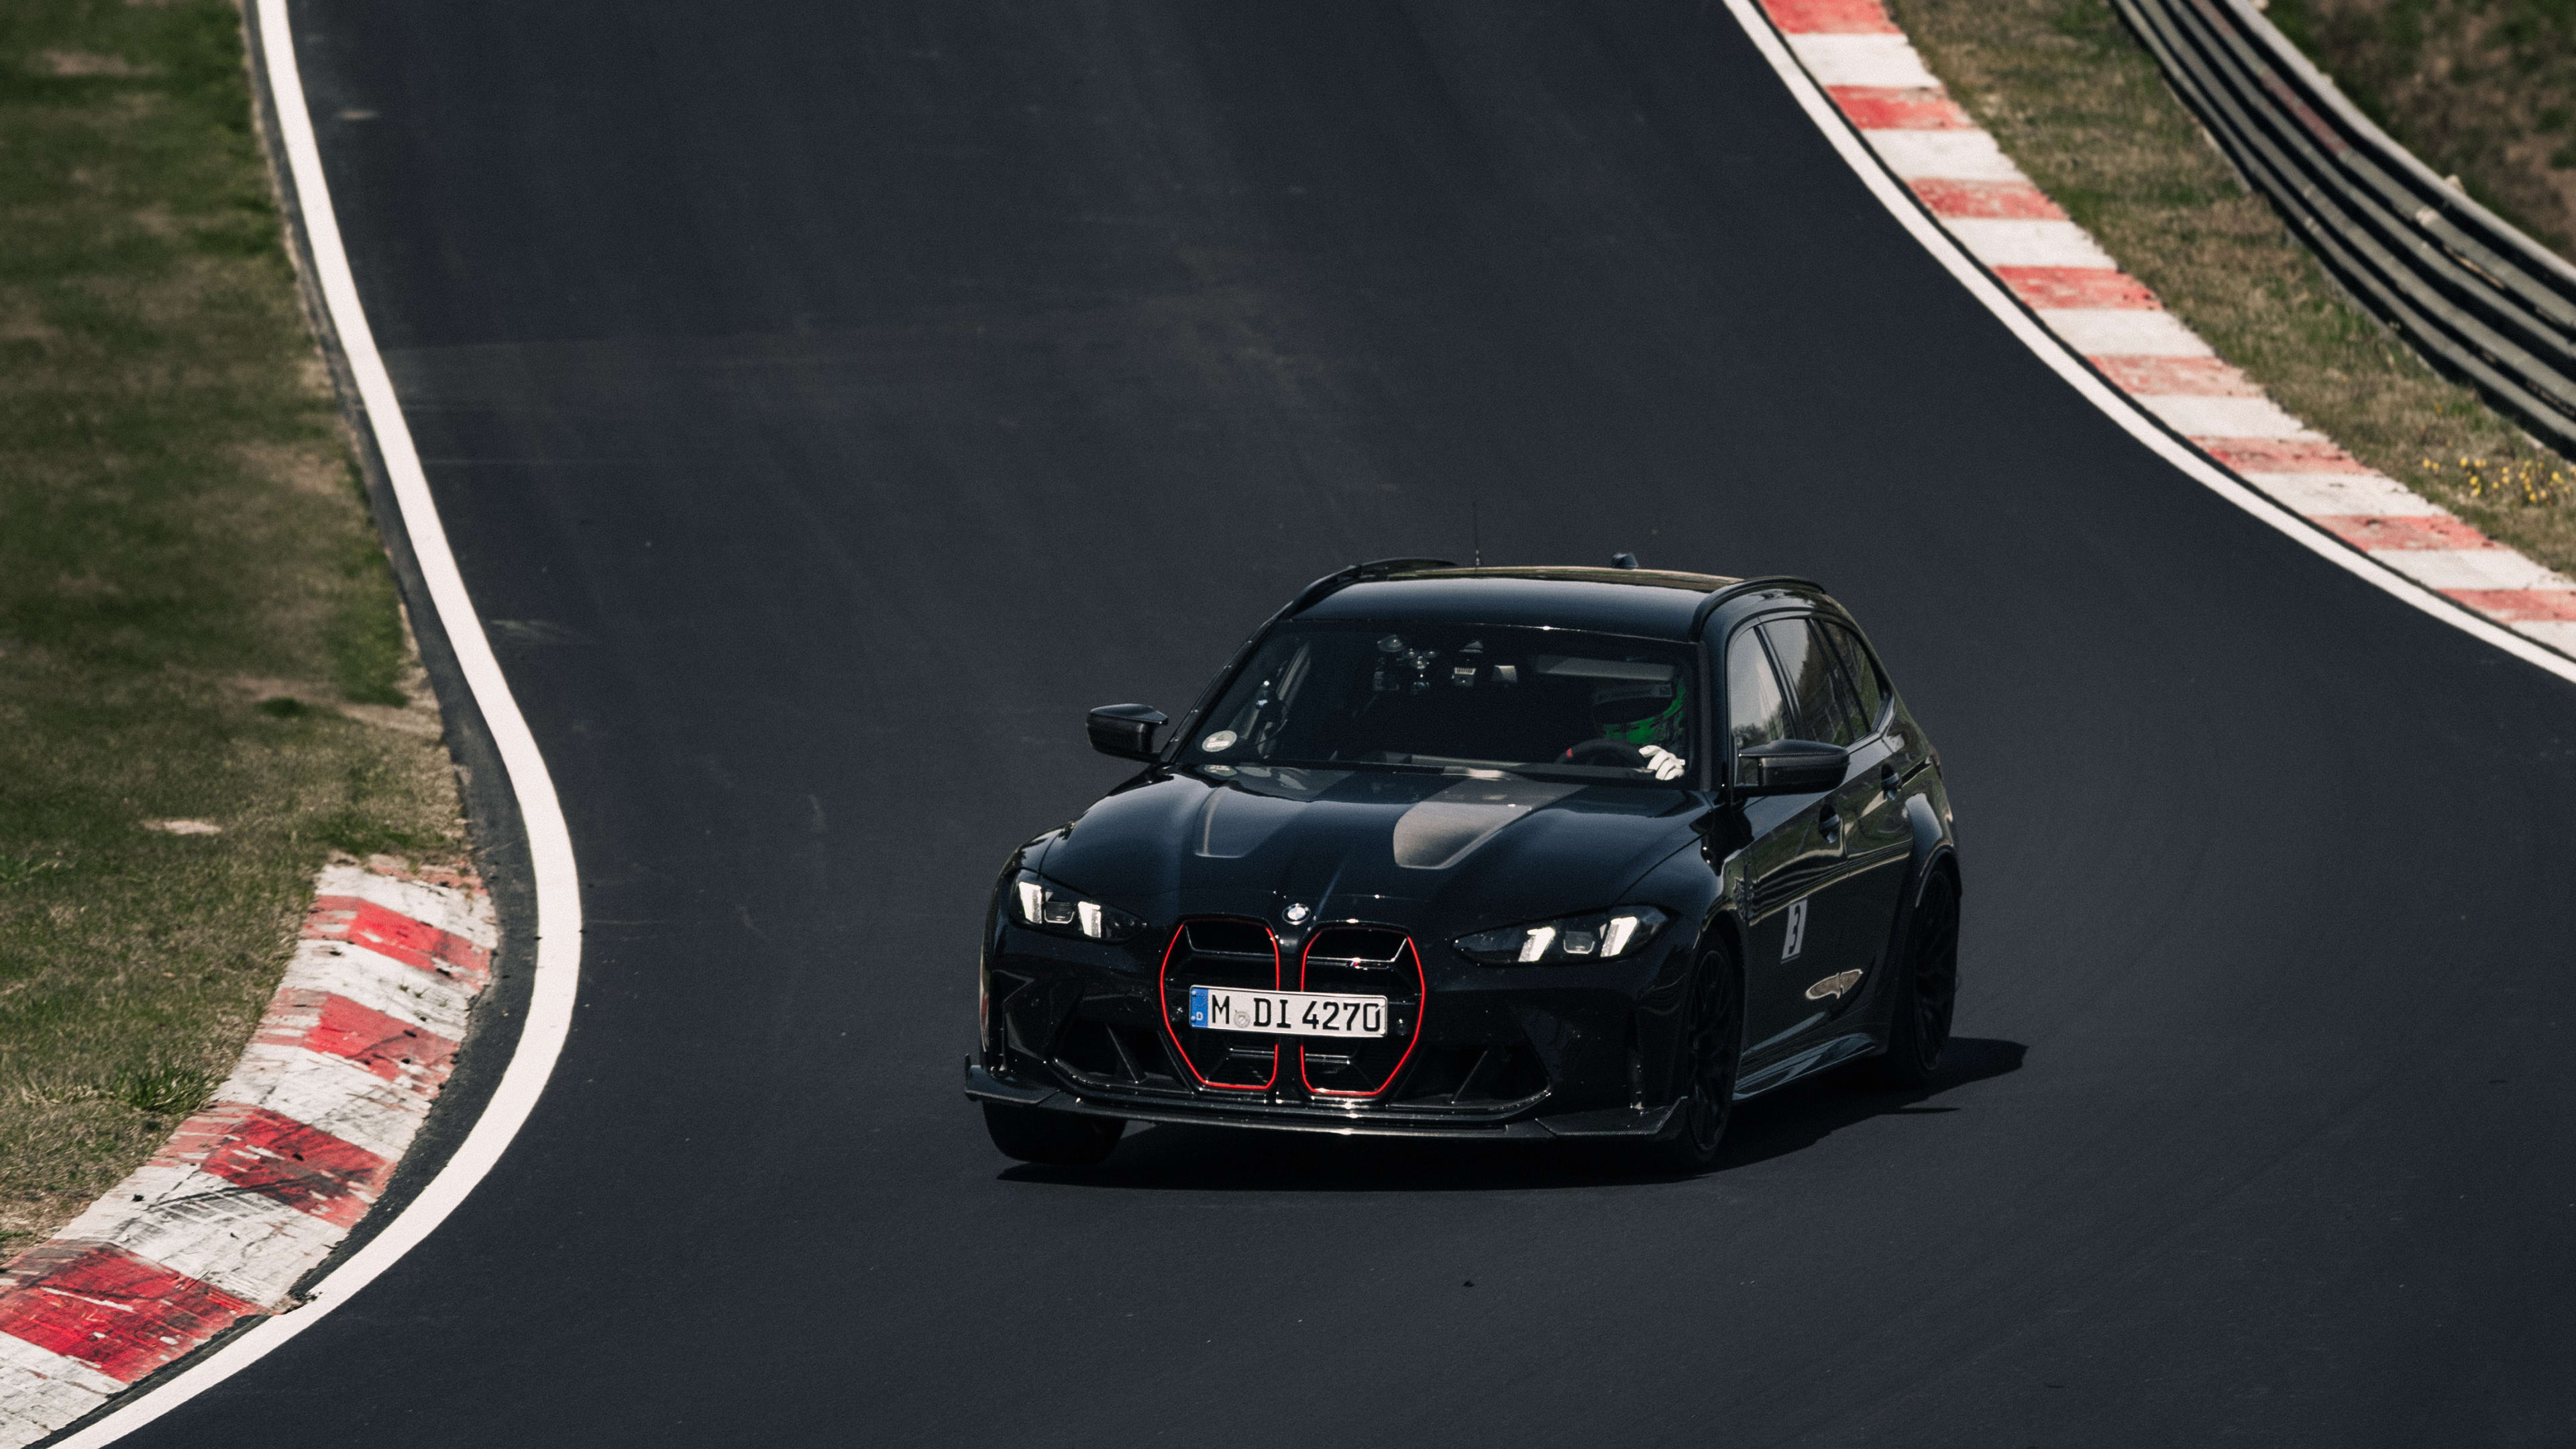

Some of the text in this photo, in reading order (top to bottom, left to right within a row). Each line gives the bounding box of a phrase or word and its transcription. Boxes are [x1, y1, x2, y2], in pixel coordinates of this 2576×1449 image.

[1788, 904, 1801, 955] 3
[1196, 1012, 1203, 1021] D
[1212, 994, 1381, 1032] M DI 4270
